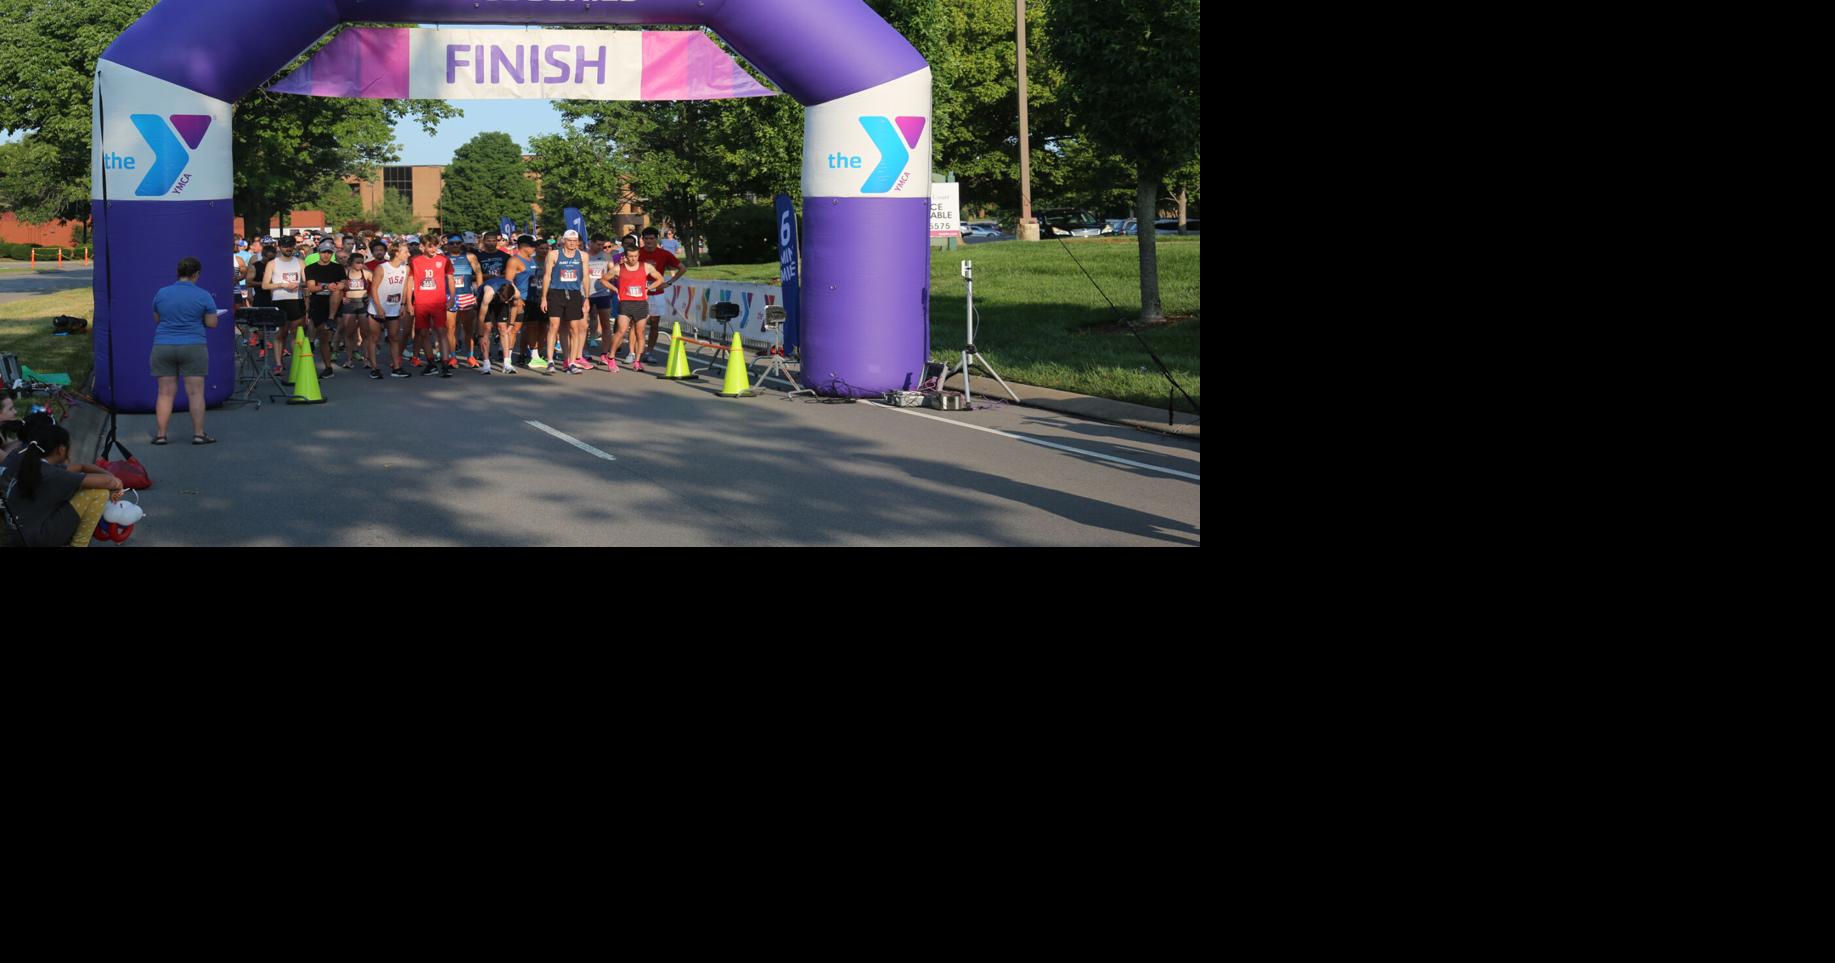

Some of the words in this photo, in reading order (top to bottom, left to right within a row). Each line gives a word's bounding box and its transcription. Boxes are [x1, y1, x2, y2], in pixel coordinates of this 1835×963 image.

[446, 44, 607, 85] FINISH
[103, 151, 136, 170] the
[827, 151, 863, 169] the
[172, 173, 192, 195] YMCA
[894, 171, 911, 192] YMCA
[780, 209, 791, 247] 6
[425, 269, 434, 278] 10
